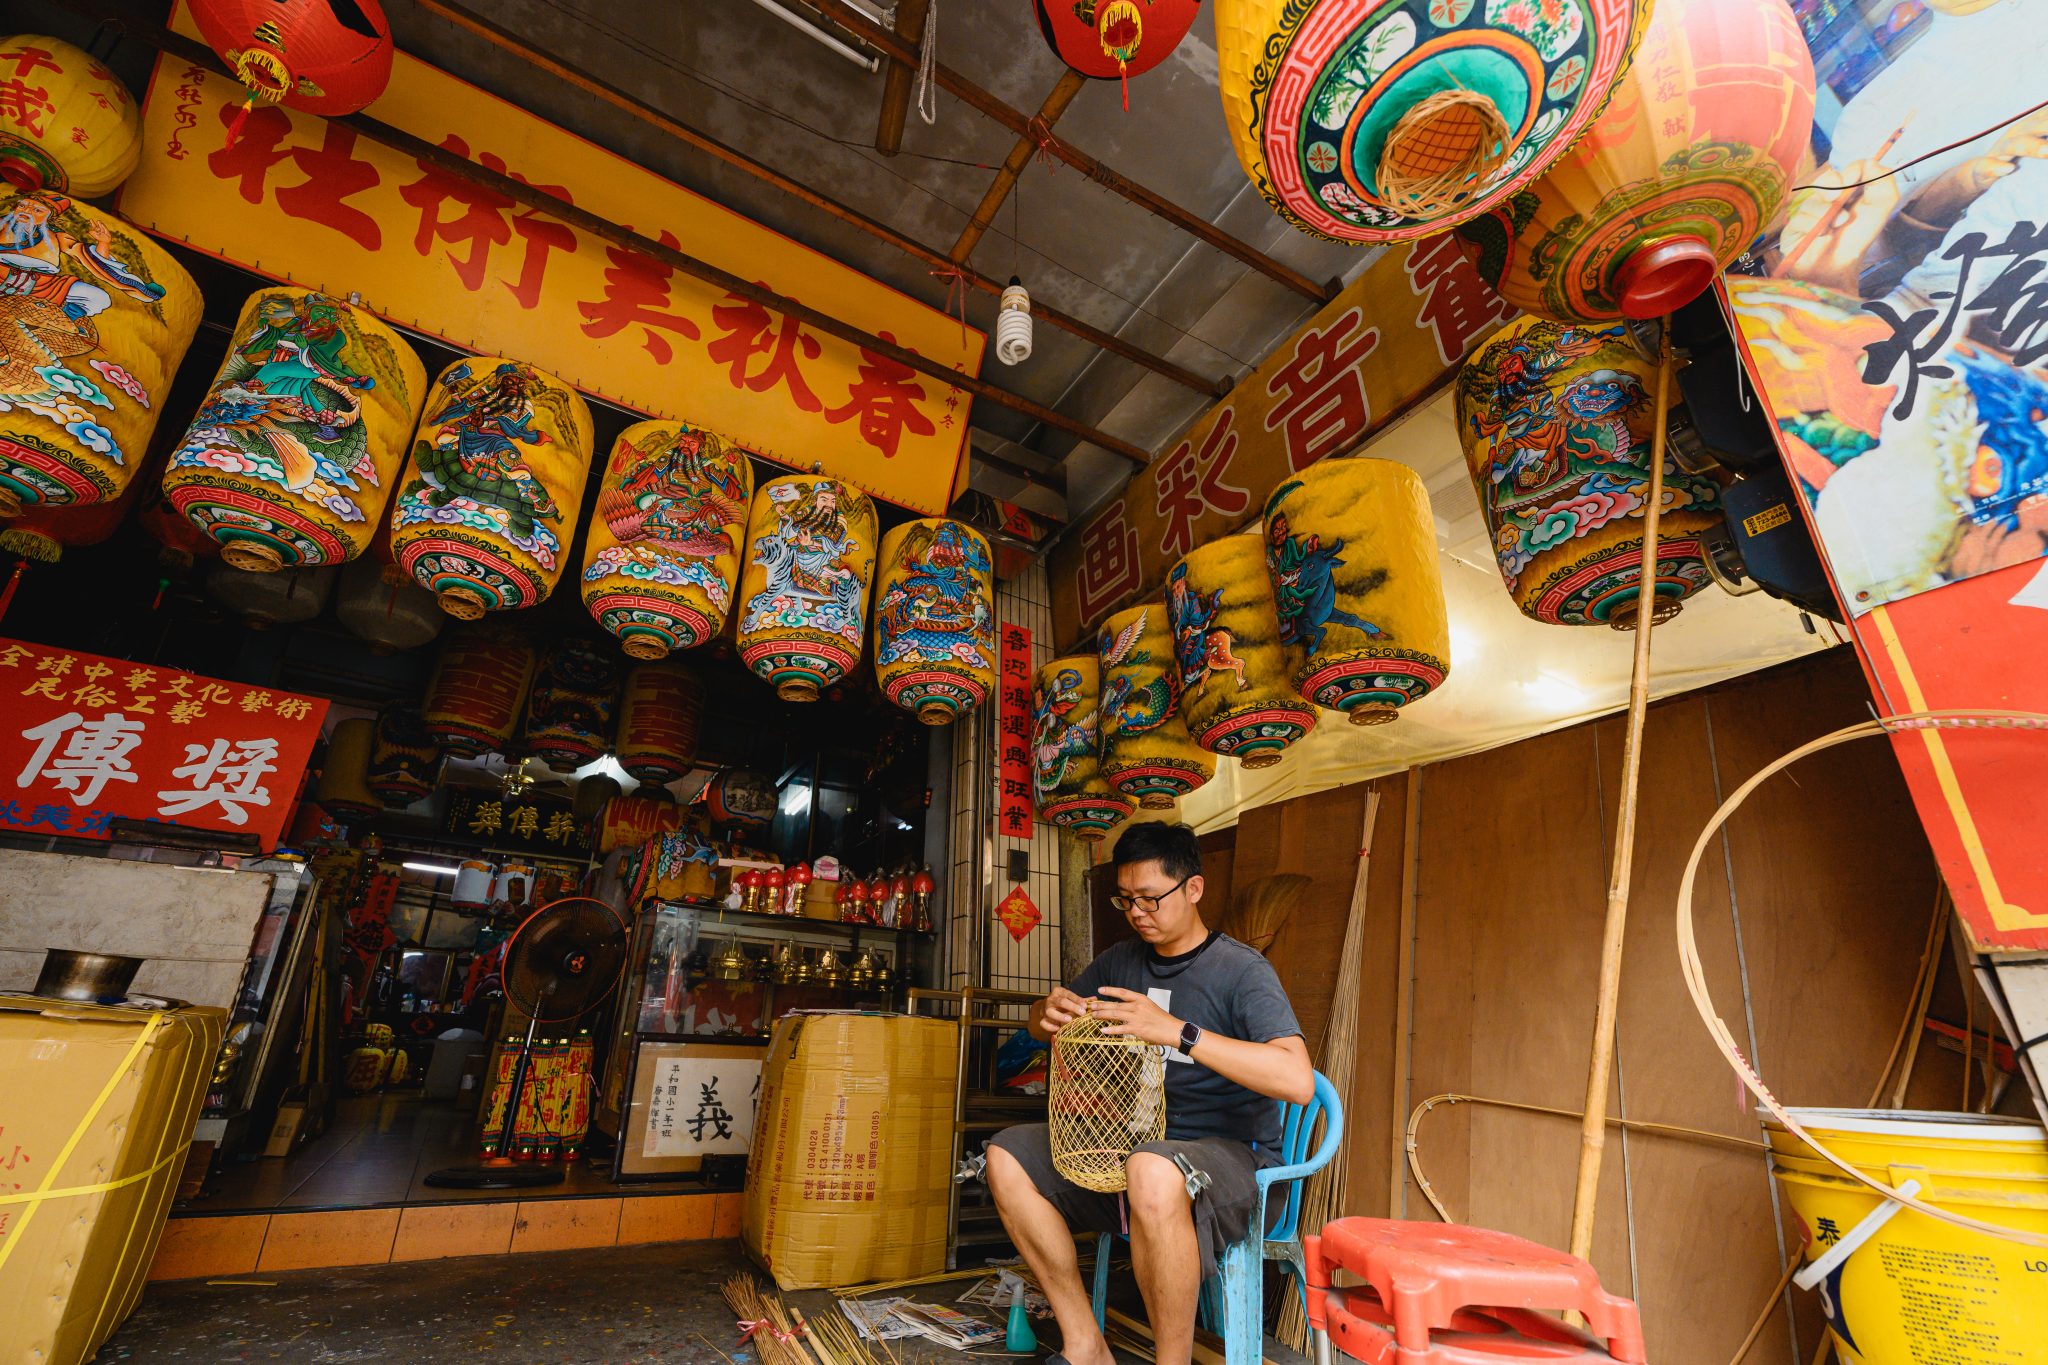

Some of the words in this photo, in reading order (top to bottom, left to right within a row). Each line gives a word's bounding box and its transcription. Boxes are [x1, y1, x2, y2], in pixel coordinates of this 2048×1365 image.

[0, 644, 313, 722] 全球中華文化藝術
[21, 677, 207, 726] 民俗工藝
[1003, 629, 1029, 831] 春迎鴻運興旺業
